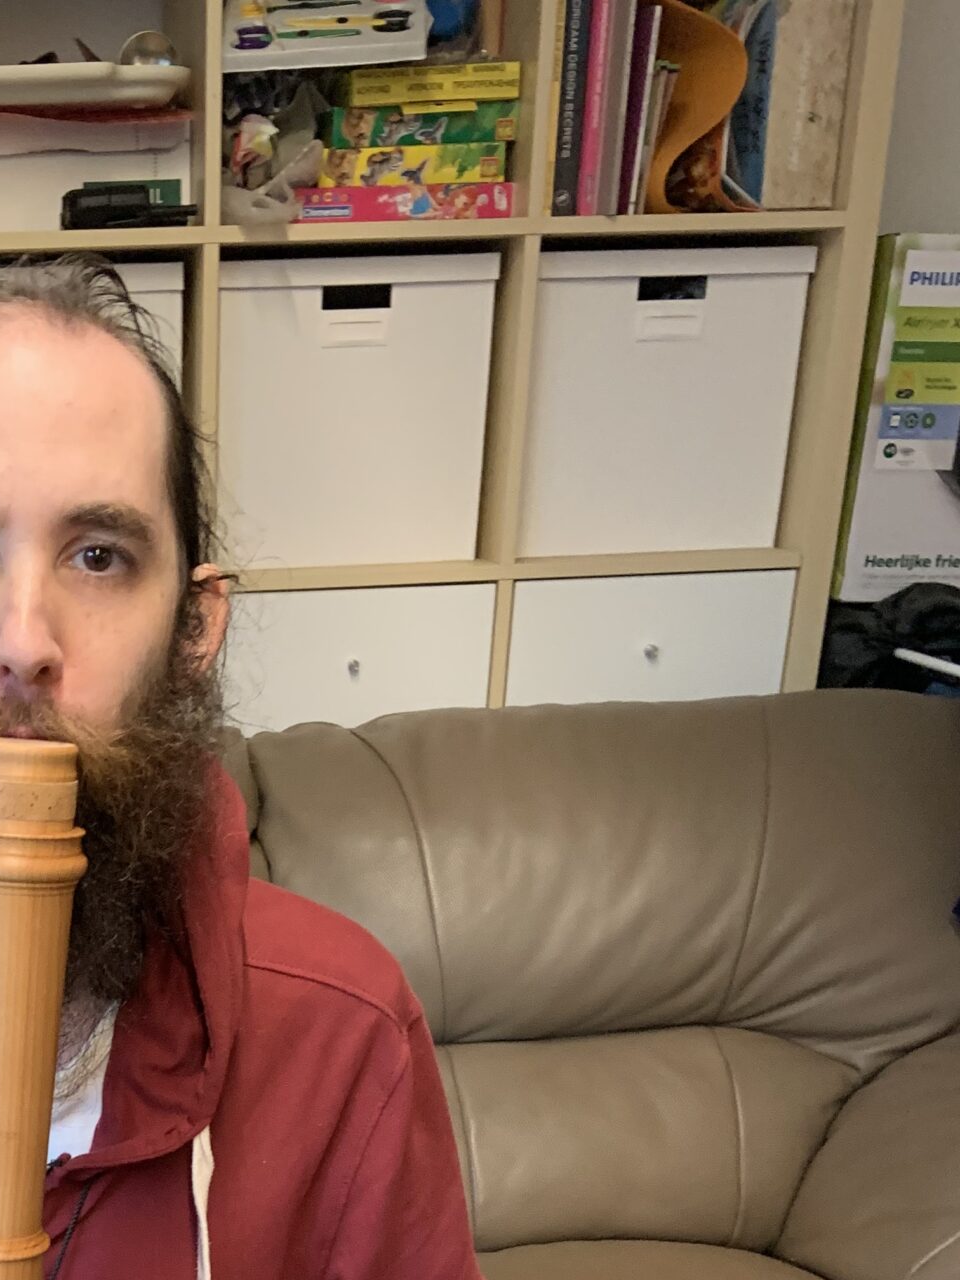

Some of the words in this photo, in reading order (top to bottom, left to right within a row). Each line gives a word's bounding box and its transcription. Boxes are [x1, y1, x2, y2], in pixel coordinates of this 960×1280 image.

[567, 0, 582, 51] ORIGAMI
[565, 54, 579, 100] DESIGN
[560, 103, 575, 158] SECRETS
[864, 553, 931, 571] Heerlijke
